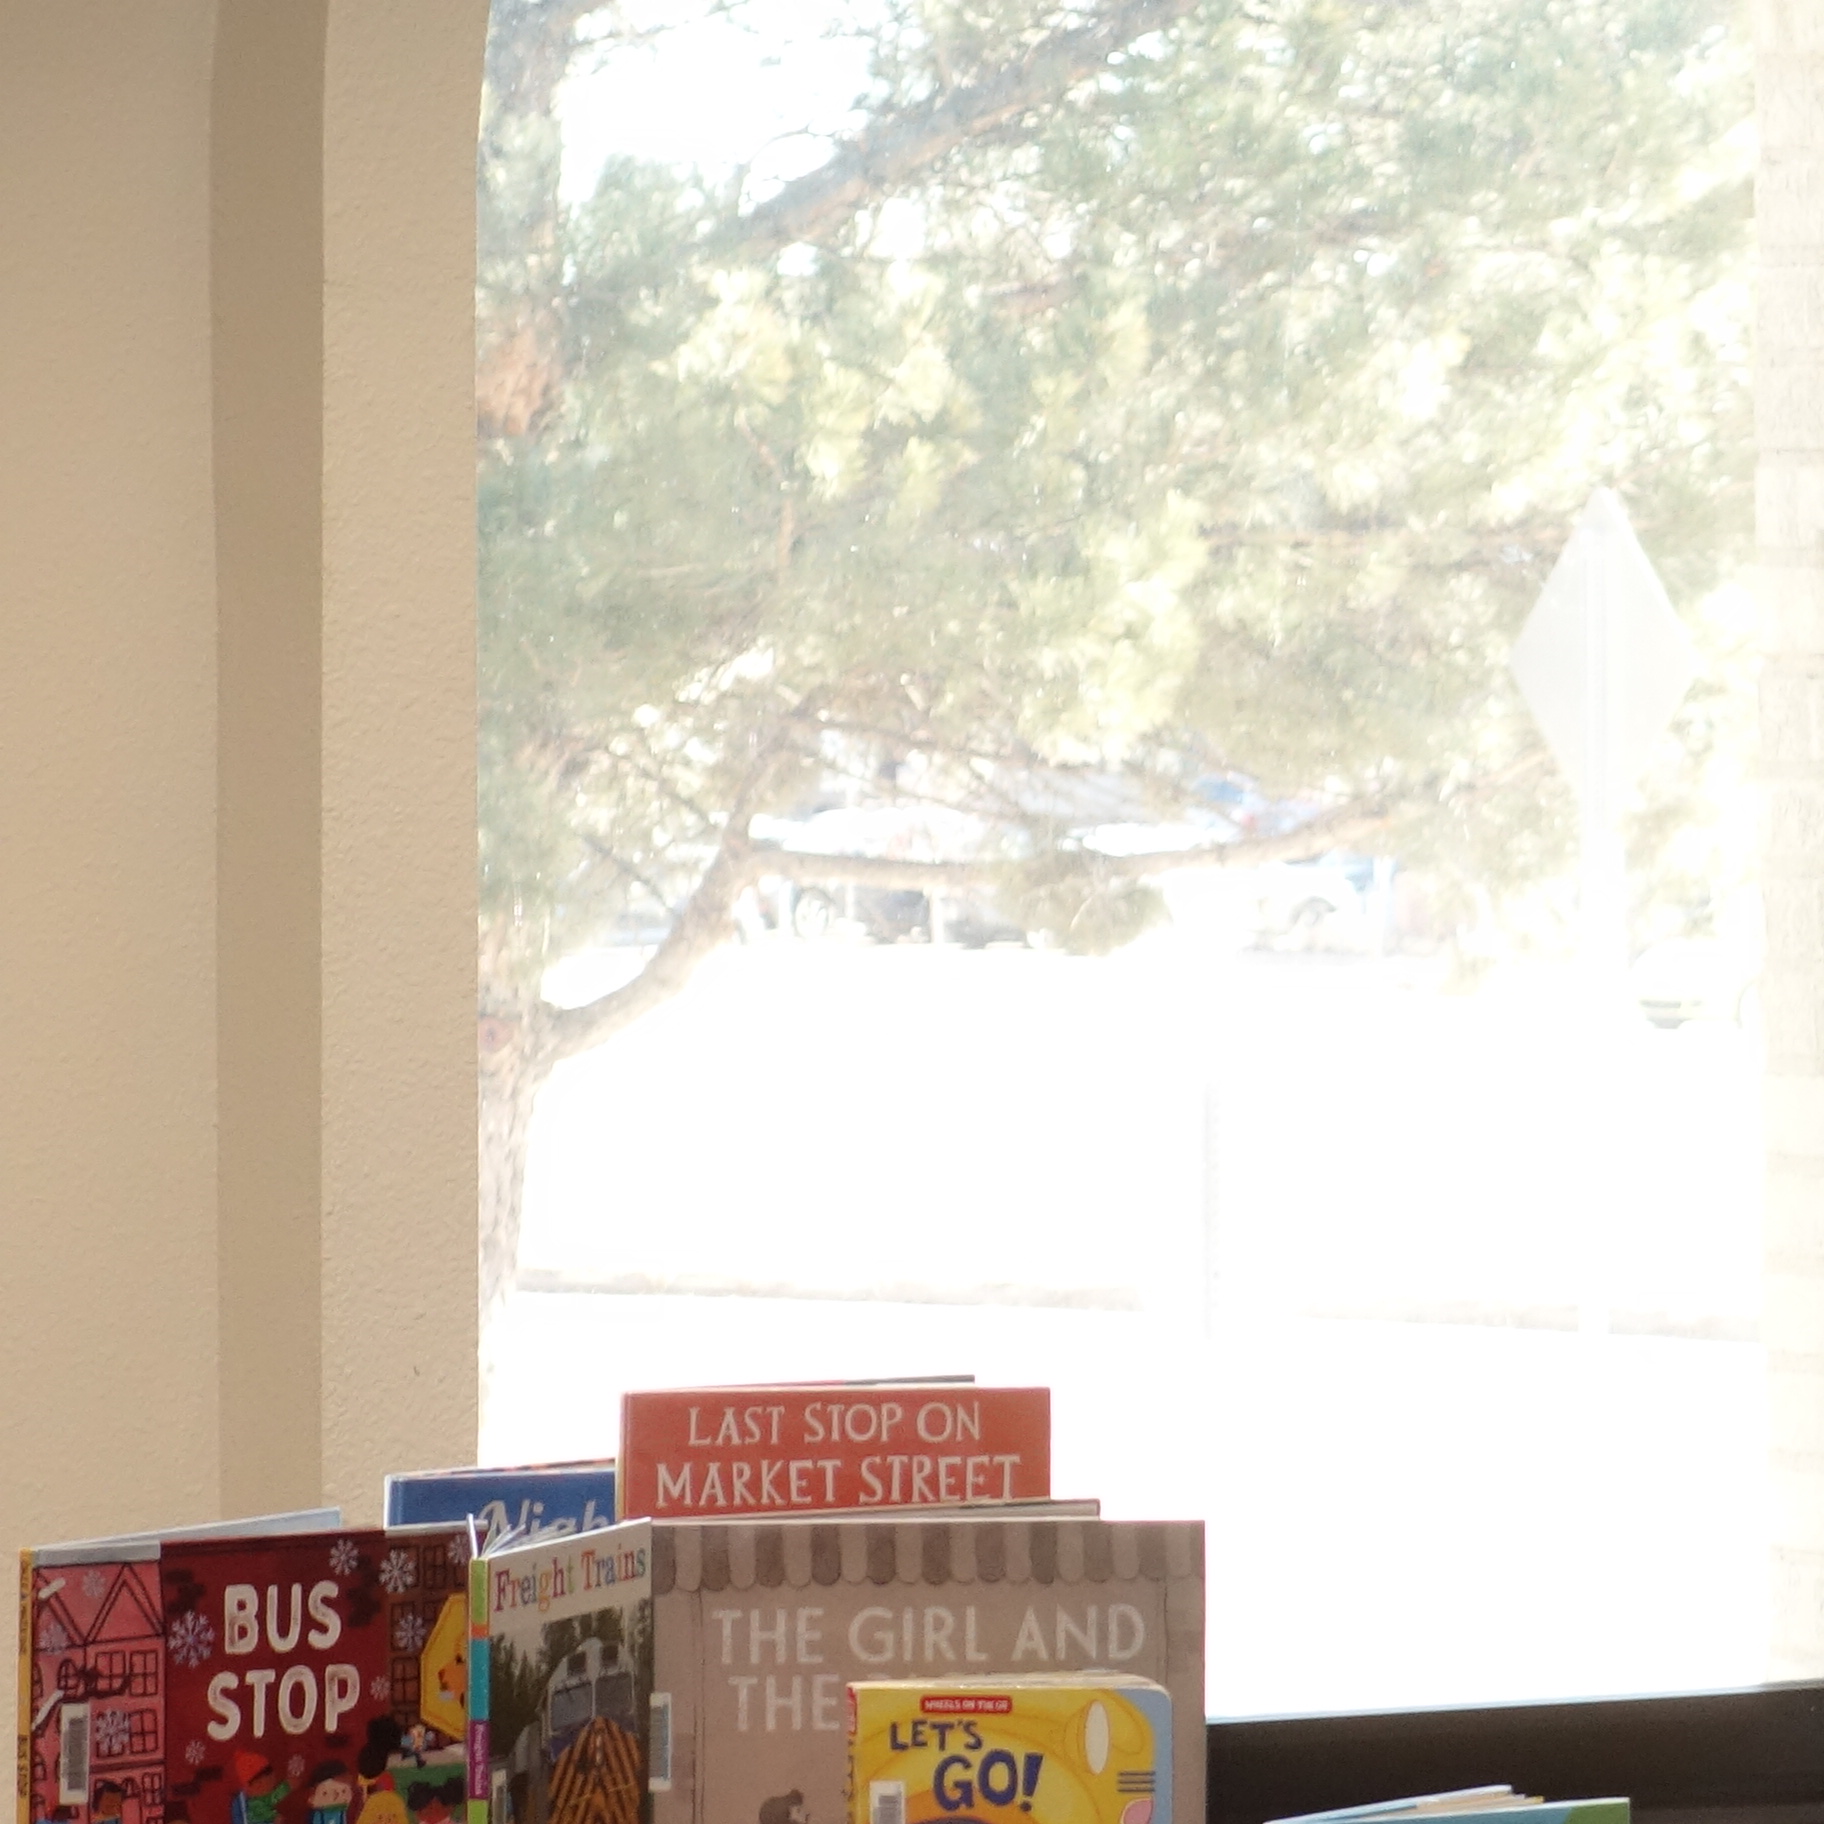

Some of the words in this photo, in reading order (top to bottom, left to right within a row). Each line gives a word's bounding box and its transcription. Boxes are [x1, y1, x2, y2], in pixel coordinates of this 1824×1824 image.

[687, 1404, 786, 1448] LAST
[803, 1401, 902, 1444] STOP
[915, 1400, 983, 1443] ON
[655, 1458, 843, 1509] MARKET
[859, 1454, 1022, 1504] STREET
[494, 1554, 577, 1613] Freight
[581, 1542, 647, 1592] Trains
[223, 1580, 344, 1655] BUS
[712, 1606, 826, 1665] THE
[847, 1605, 987, 1664] GIRL
[1011, 1602, 1147, 1661] AND
[206, 1663, 362, 1742] STOP
[728, 1674, 841, 1734] THE
[889, 1718, 983, 1751] LET'S
[933, 1748, 1045, 1813] GO!
